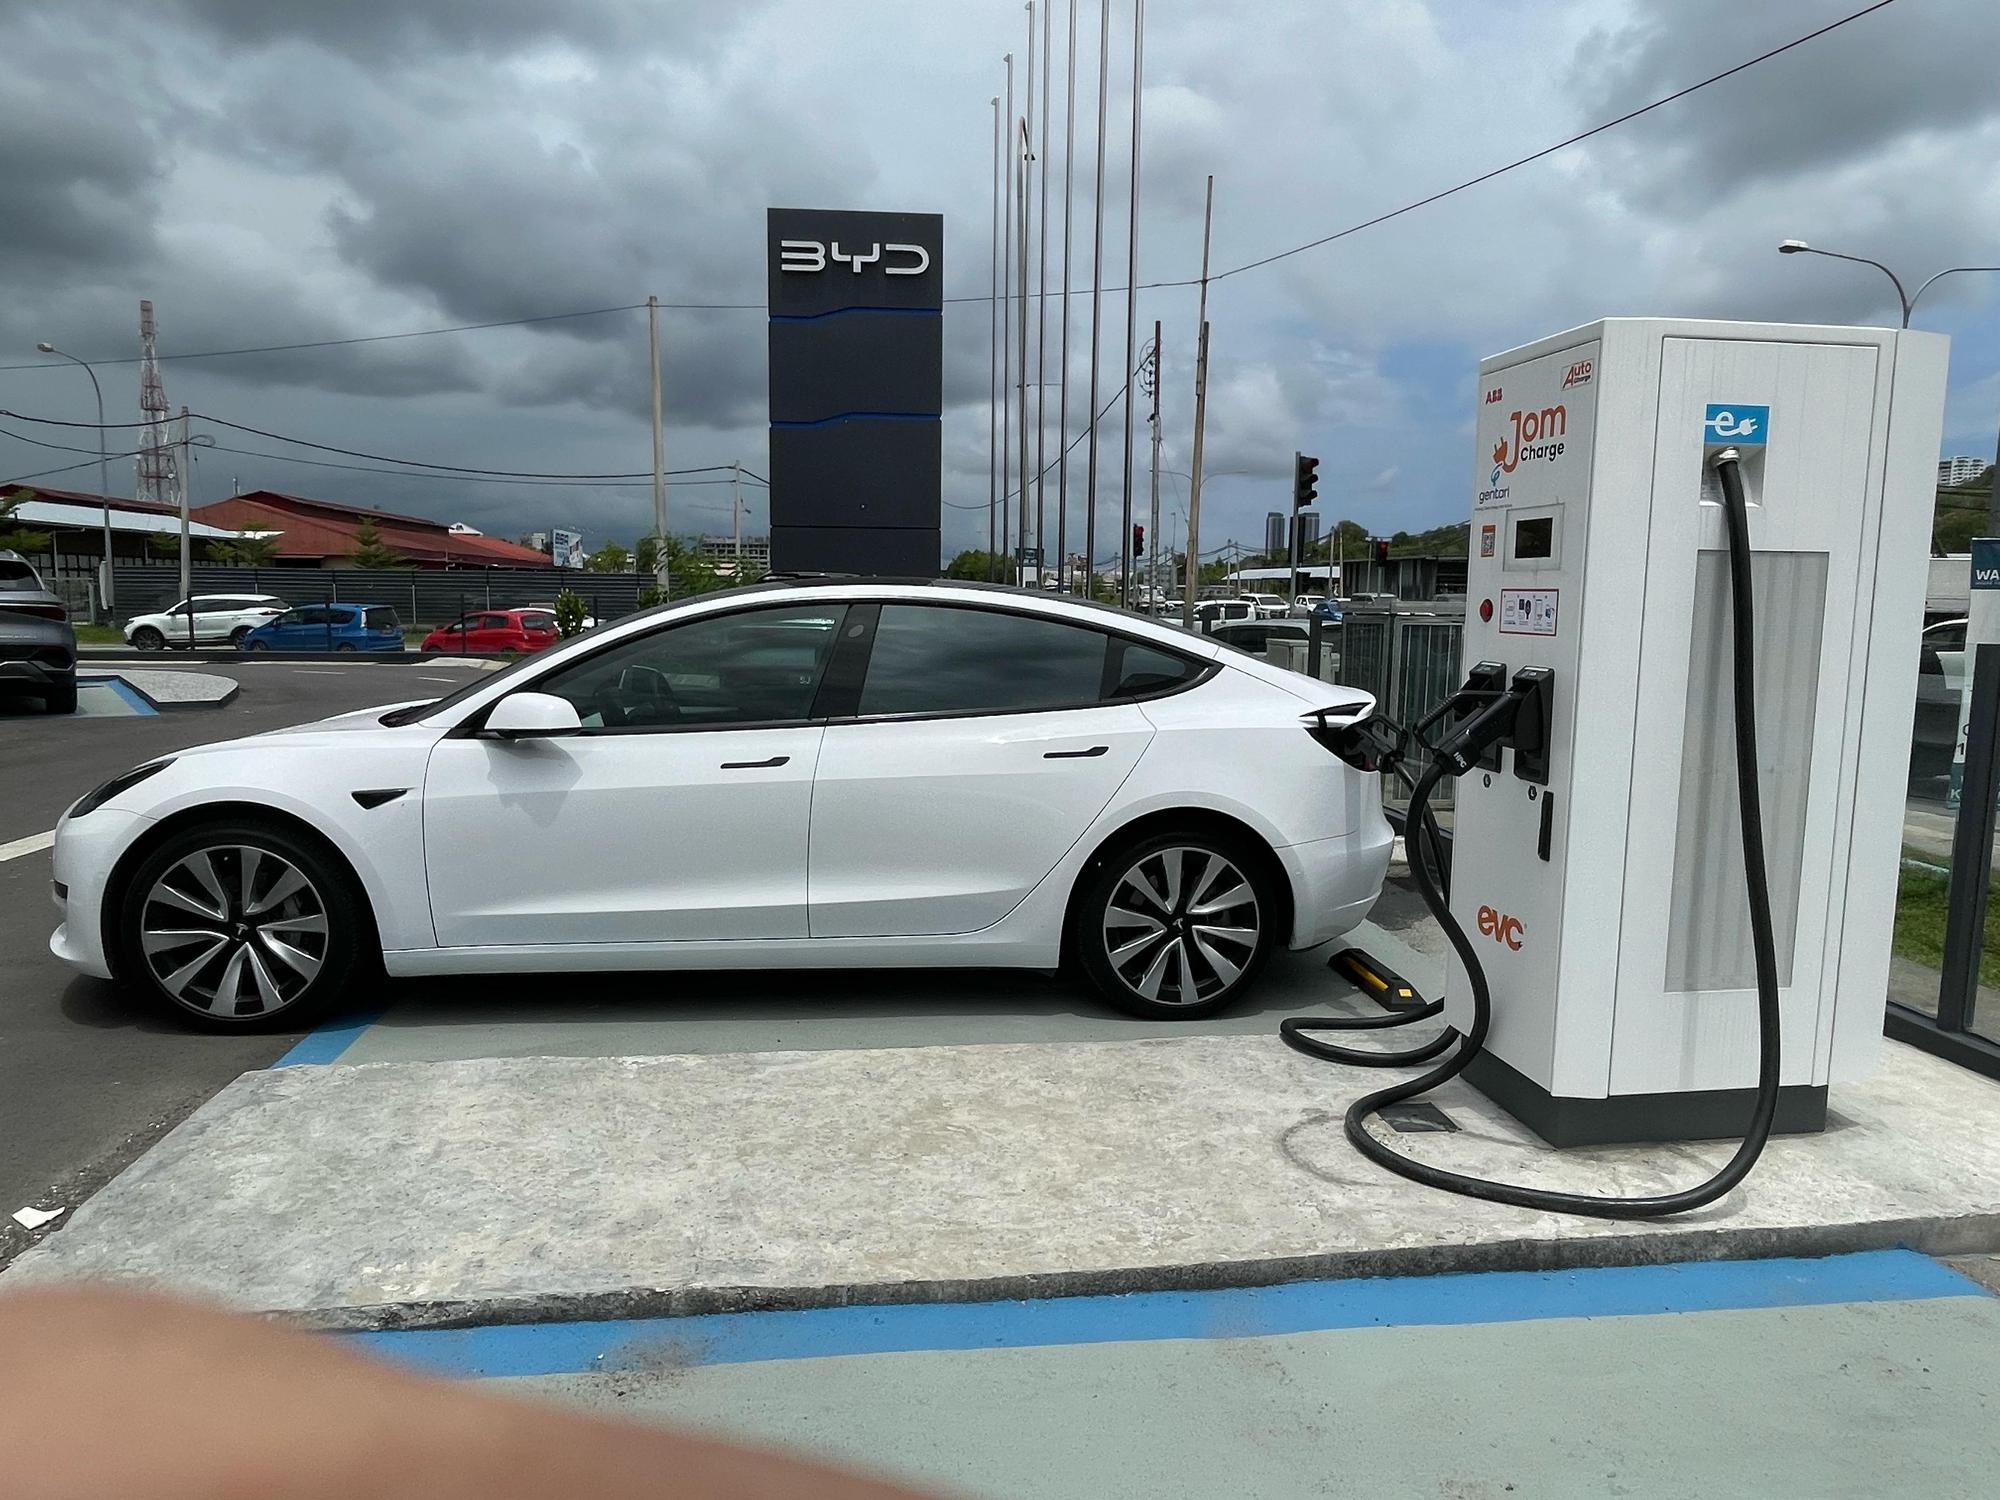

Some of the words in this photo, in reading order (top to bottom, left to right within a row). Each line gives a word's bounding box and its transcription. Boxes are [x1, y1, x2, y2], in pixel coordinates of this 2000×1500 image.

[780, 239, 930, 275] BYD
[1562, 361, 1592, 389] Auto
[1485, 387, 1503, 405] ABB
[1509, 405, 1567, 473] Jom
[1520, 442, 1565, 462] Charge
[1479, 485, 1510, 504] gentari
[1477, 904, 1524, 952] evc
